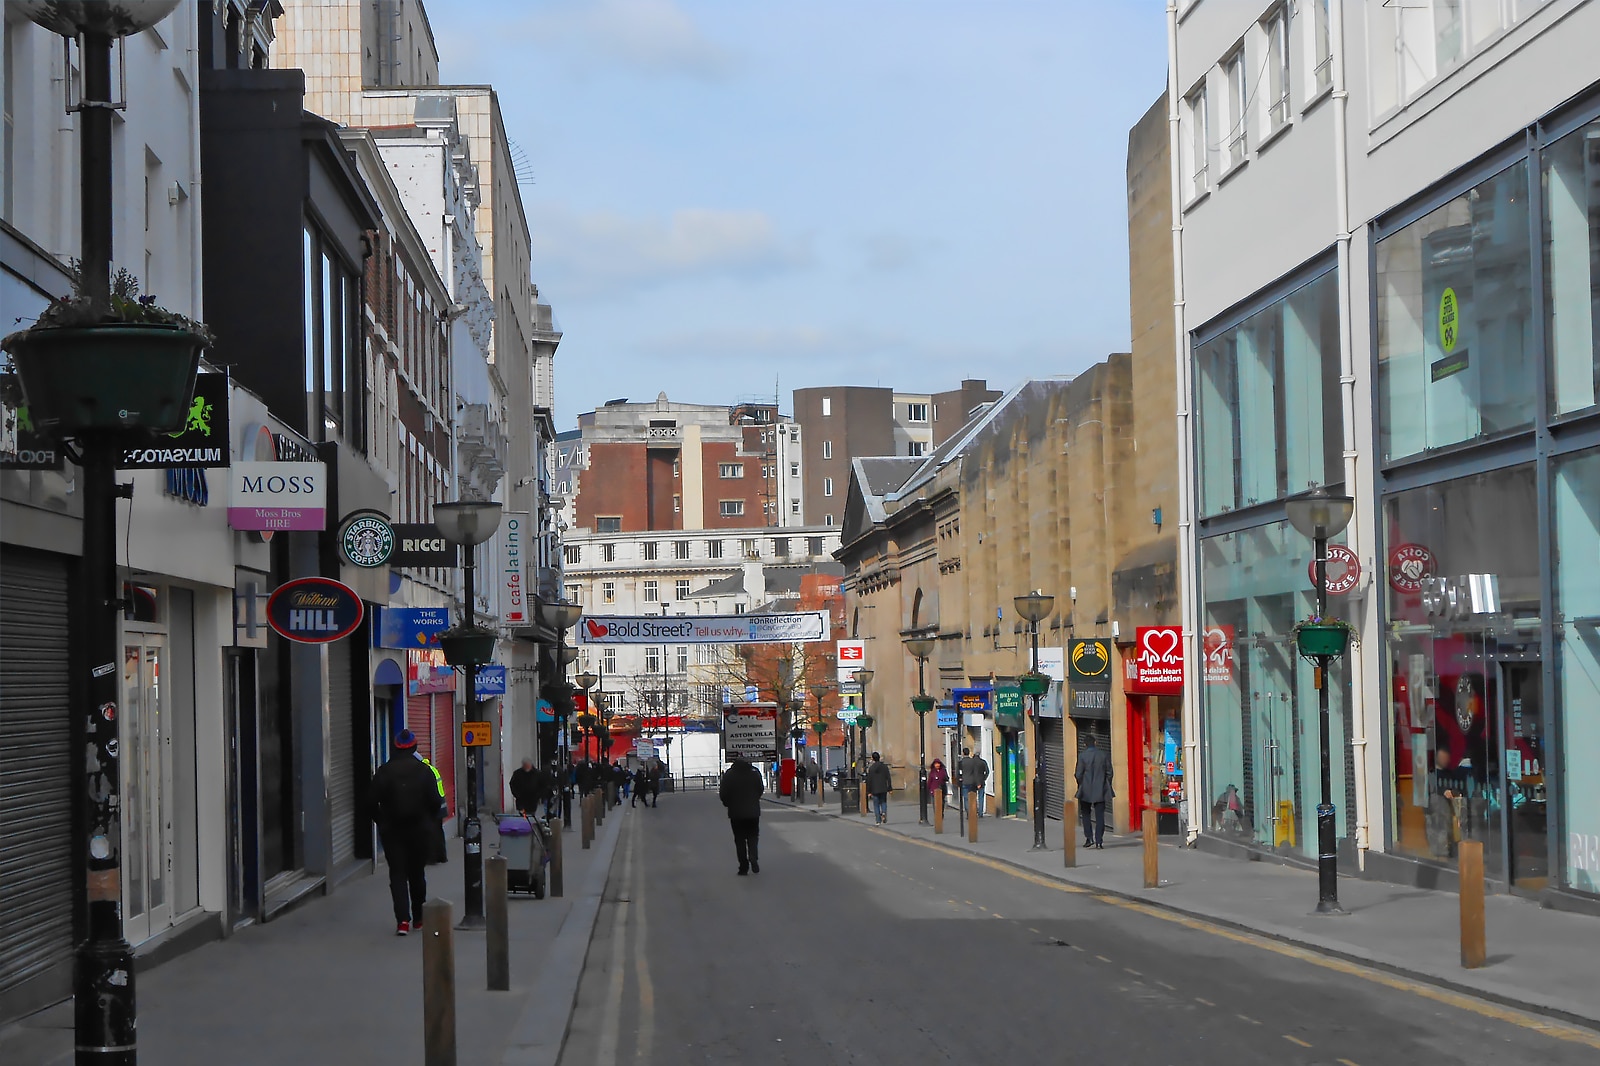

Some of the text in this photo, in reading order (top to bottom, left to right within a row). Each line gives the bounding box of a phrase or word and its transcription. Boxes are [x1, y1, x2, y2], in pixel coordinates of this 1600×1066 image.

[241, 476, 314, 493] MOSS
[255, 509, 301, 518] Moss Bros
[265, 519, 291, 528] HIRE
[346, 520, 391, 542] STARBUCKS
[402, 538, 446, 552] RICCI
[350, 551, 385, 565] COFFEE
[1327, 549, 1351, 563] OSTA
[1325, 574, 1355, 591] OFFEE
[294, 591, 339, 607] William
[289, 609, 339, 631] HILL
[749, 616, 802, 625] #OnReflection
[608, 621, 640, 637] Bold
[642, 621, 693, 637] Street?
[695, 626, 710, 637] Tell
[710, 628, 722, 636] us
[474, 676, 504, 684] ALIFAX
[1140, 675, 1182, 683] Foundation
